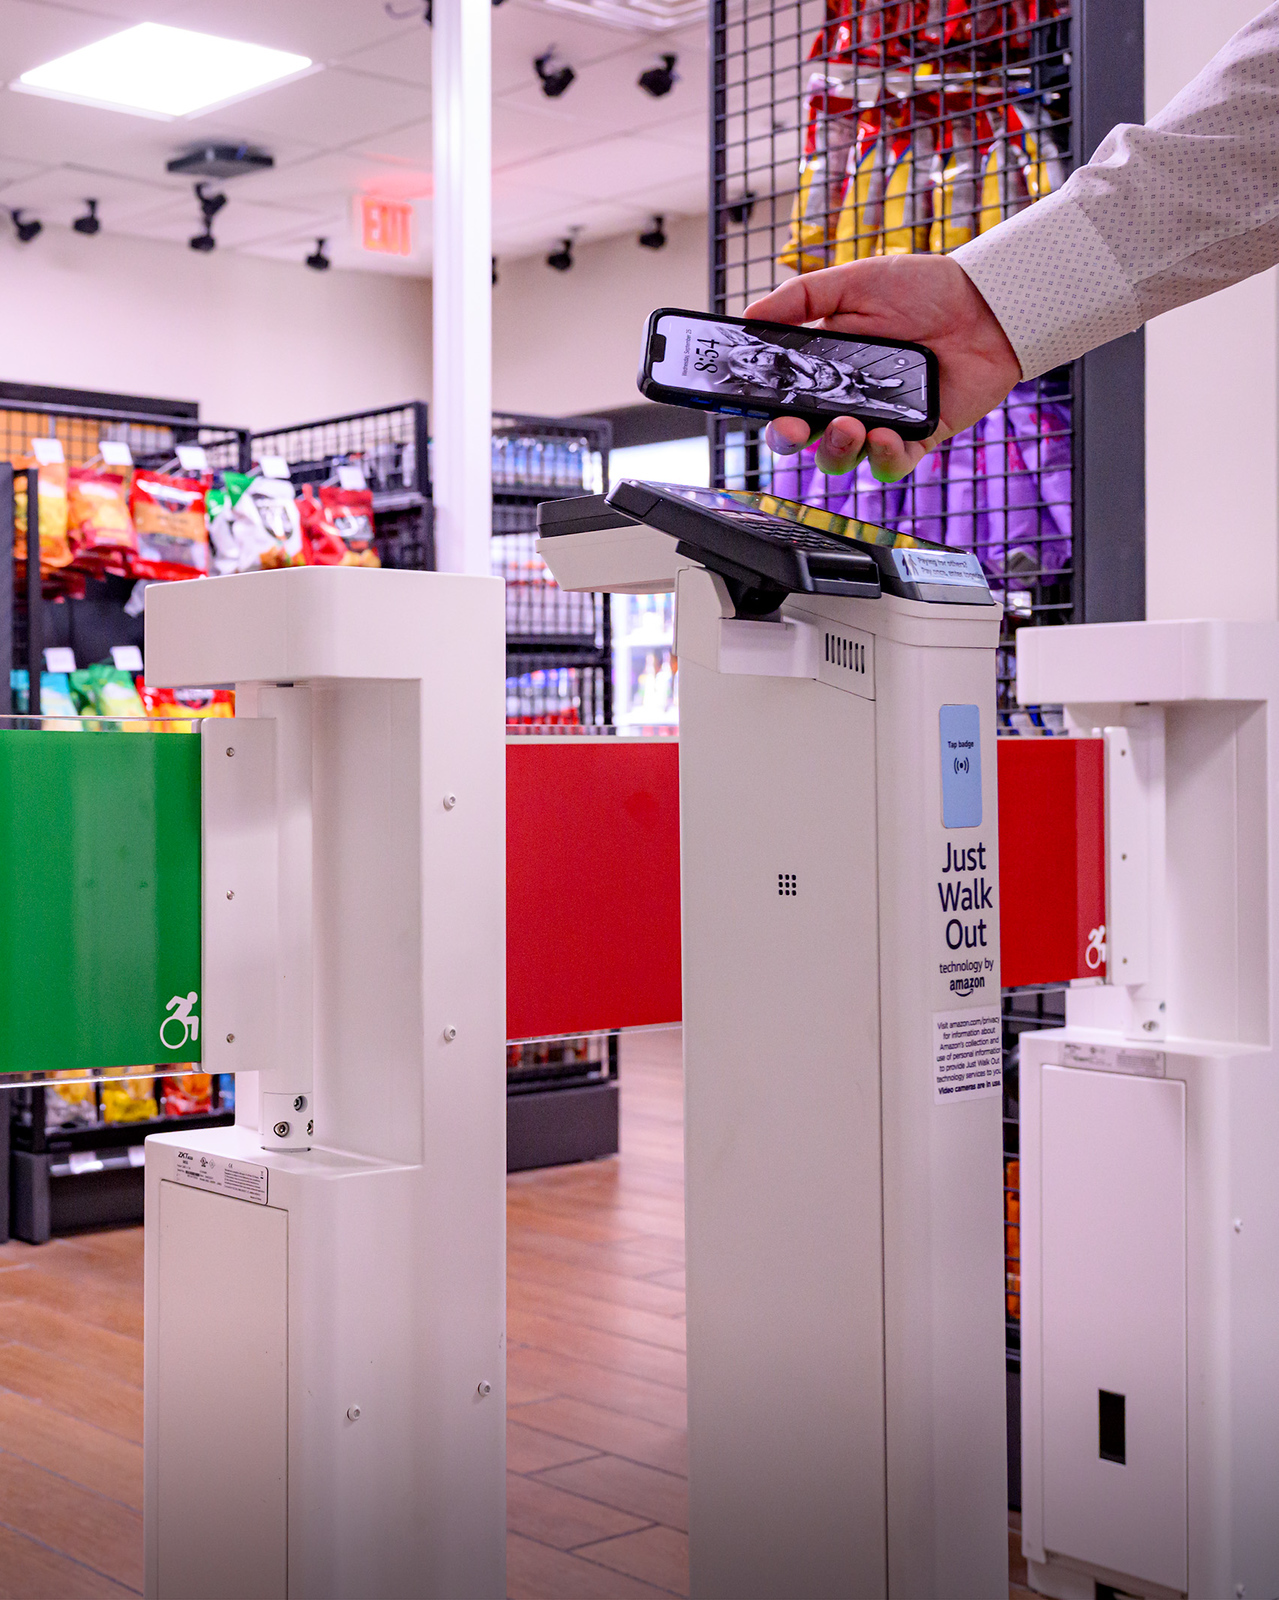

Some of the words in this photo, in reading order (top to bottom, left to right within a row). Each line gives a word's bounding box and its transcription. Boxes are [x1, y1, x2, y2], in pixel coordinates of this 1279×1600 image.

[694, 339, 719, 373] 8:54
[958, 740, 974, 749] badge
[942, 842, 986, 873] Just
[938, 878, 993, 912] Walk
[945, 918, 987, 950] Out
[939, 960, 983, 974] technology
[984, 958, 994, 972] by
[950, 976, 985, 992] amazon
[950, 1017, 999, 1028] amazon.com/privacy
[952, 1029, 980, 1039] information
[965, 1039, 989, 1047] collection
[990, 1036, 999, 1044] and
[953, 1050, 974, 1060] personal
[946, 1063, 965, 1072] provide
[936, 1074, 965, 1083] technology
[966, 1070, 985, 1079] services
[938, 1087, 954, 1095] Video
[955, 1084, 976, 1092] cameras
